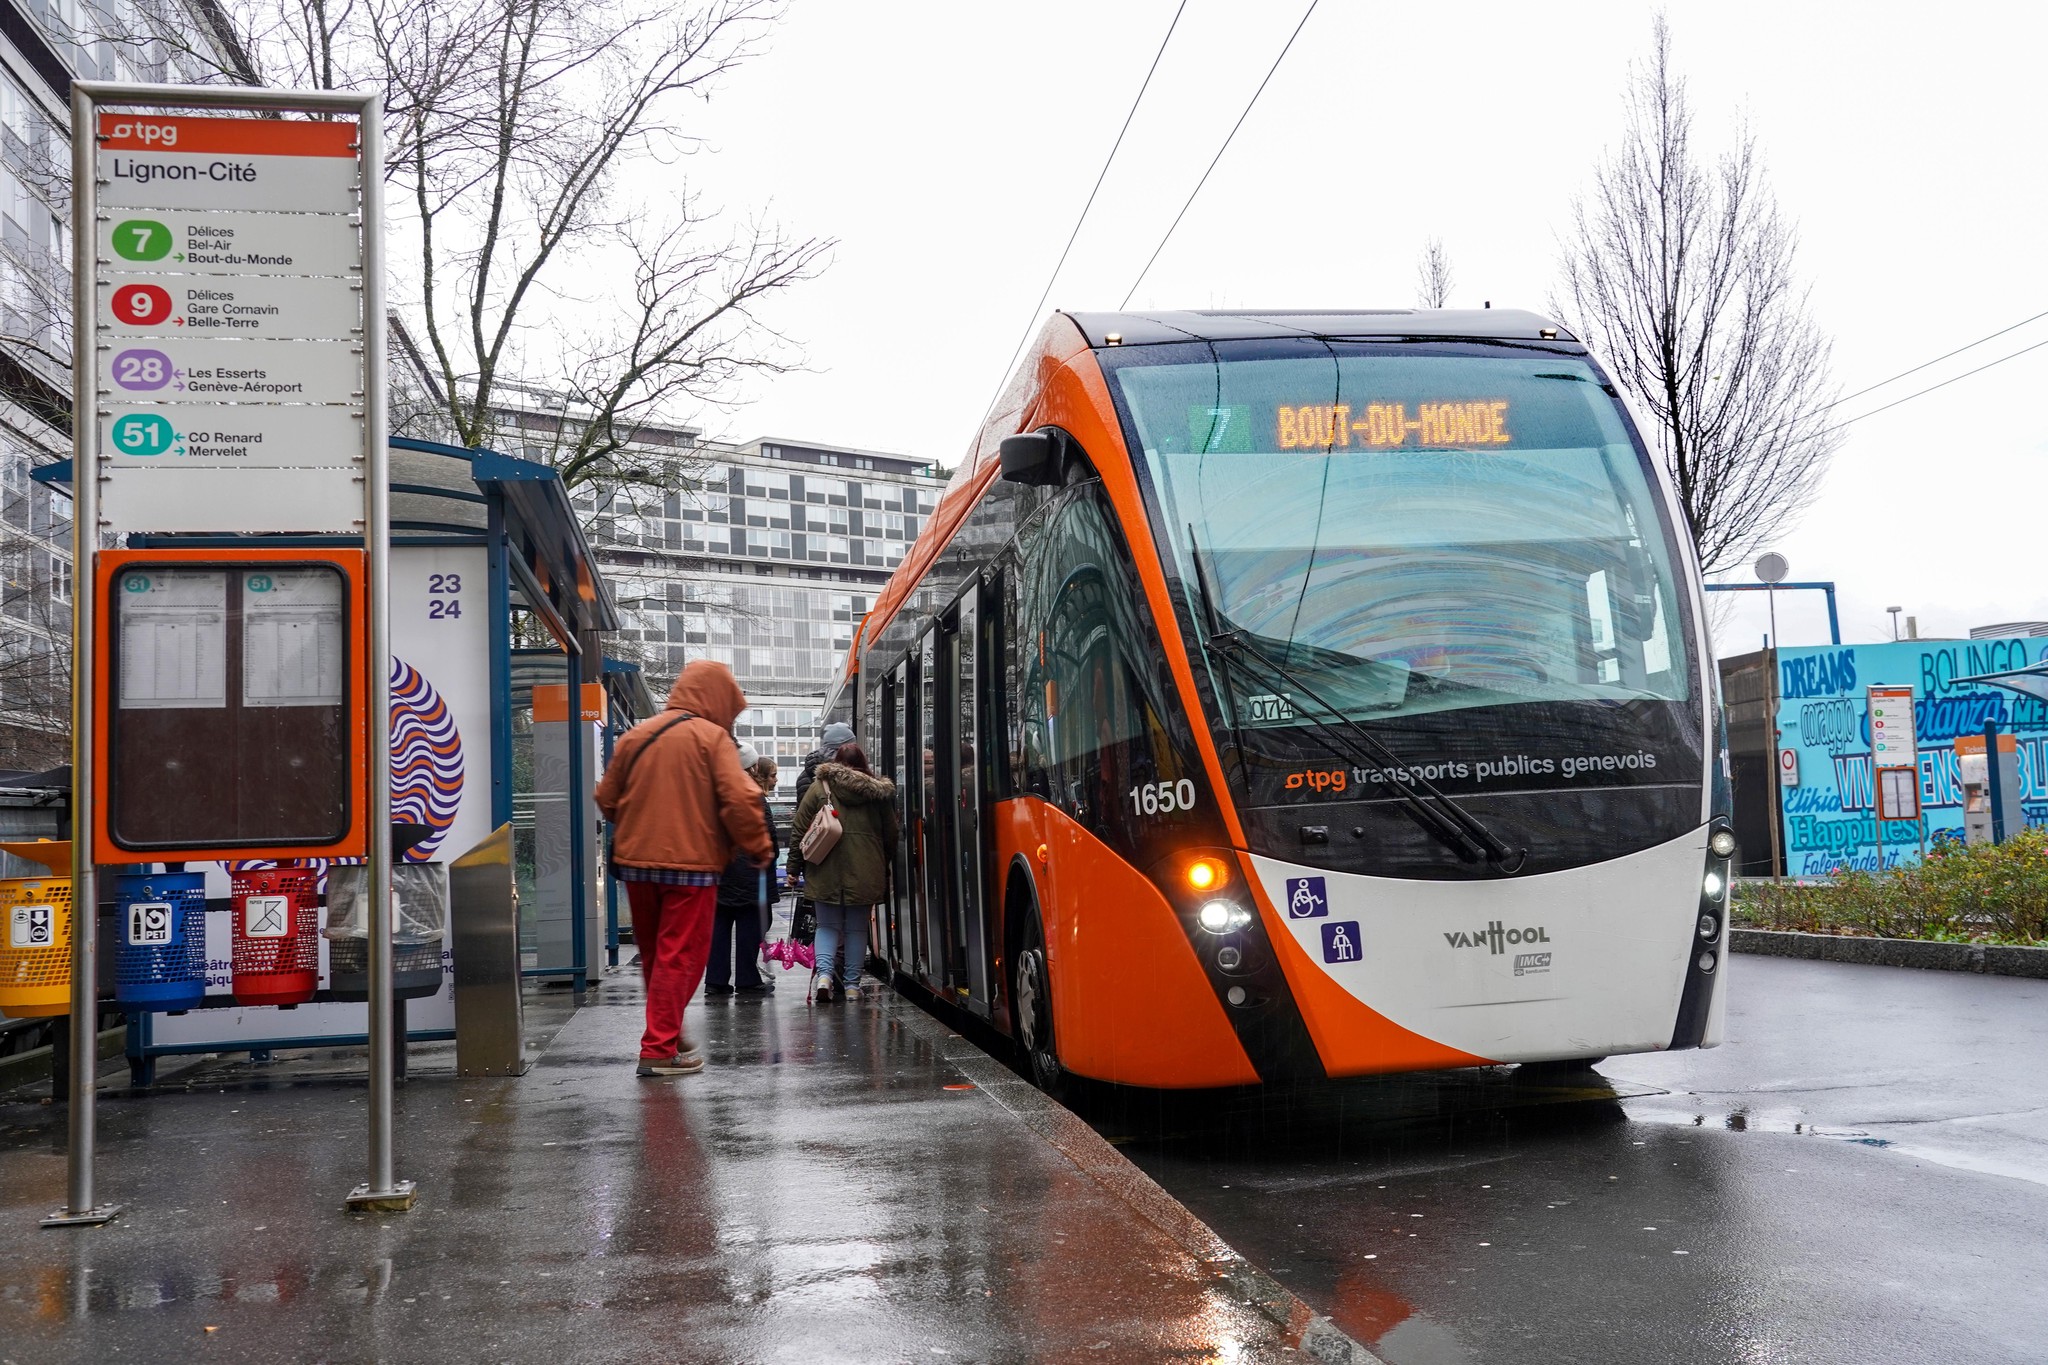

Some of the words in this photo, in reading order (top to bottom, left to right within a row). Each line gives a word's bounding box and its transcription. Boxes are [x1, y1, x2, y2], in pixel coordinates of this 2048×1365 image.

[114, 158, 257, 184] Lignon-Cité
[187, 225, 235, 237] Délices
[132, 228, 153, 253] 7
[188, 239, 232, 251] Bel-Air
[188, 252, 293, 265] Bout-du-Monde
[187, 289, 235, 301] Délices
[130, 292, 153, 318] 9
[187, 303, 219, 315] Gare
[222, 303, 279, 315] Cornavin
[188, 316, 260, 329] Belle-Terre
[120, 356, 163, 383] 28
[188, 367, 213, 379] Les
[216, 367, 267, 380] Esserts
[188, 380, 303, 394] Genève-Aéroport
[1207, 407, 1232, 449] 7
[1278, 401, 1511, 448] BOUT-DU-MONDE
[122, 422, 160, 447] 51
[188, 432, 210, 443] CO
[214, 432, 263, 444] Renard
[188, 446, 248, 457] Mervelet
[128, 578, 147, 590] 51
[251, 578, 269, 589] 51
[428, 573, 462, 594] 23
[428, 600, 462, 619] 24
[1781, 649, 1856, 700] DREAMS
[1921, 639, 2028, 697] BOLINGO
[1251, 699, 1293, 719] 074
[1352, 761, 1469, 787] transports
[1475, 754, 1555, 783] publics
[1561, 750, 1657, 779] genevois
[1129, 778, 1196, 816] 1650
[146, 930, 165, 939] PET
[1520, 954, 1542, 967] IMC
